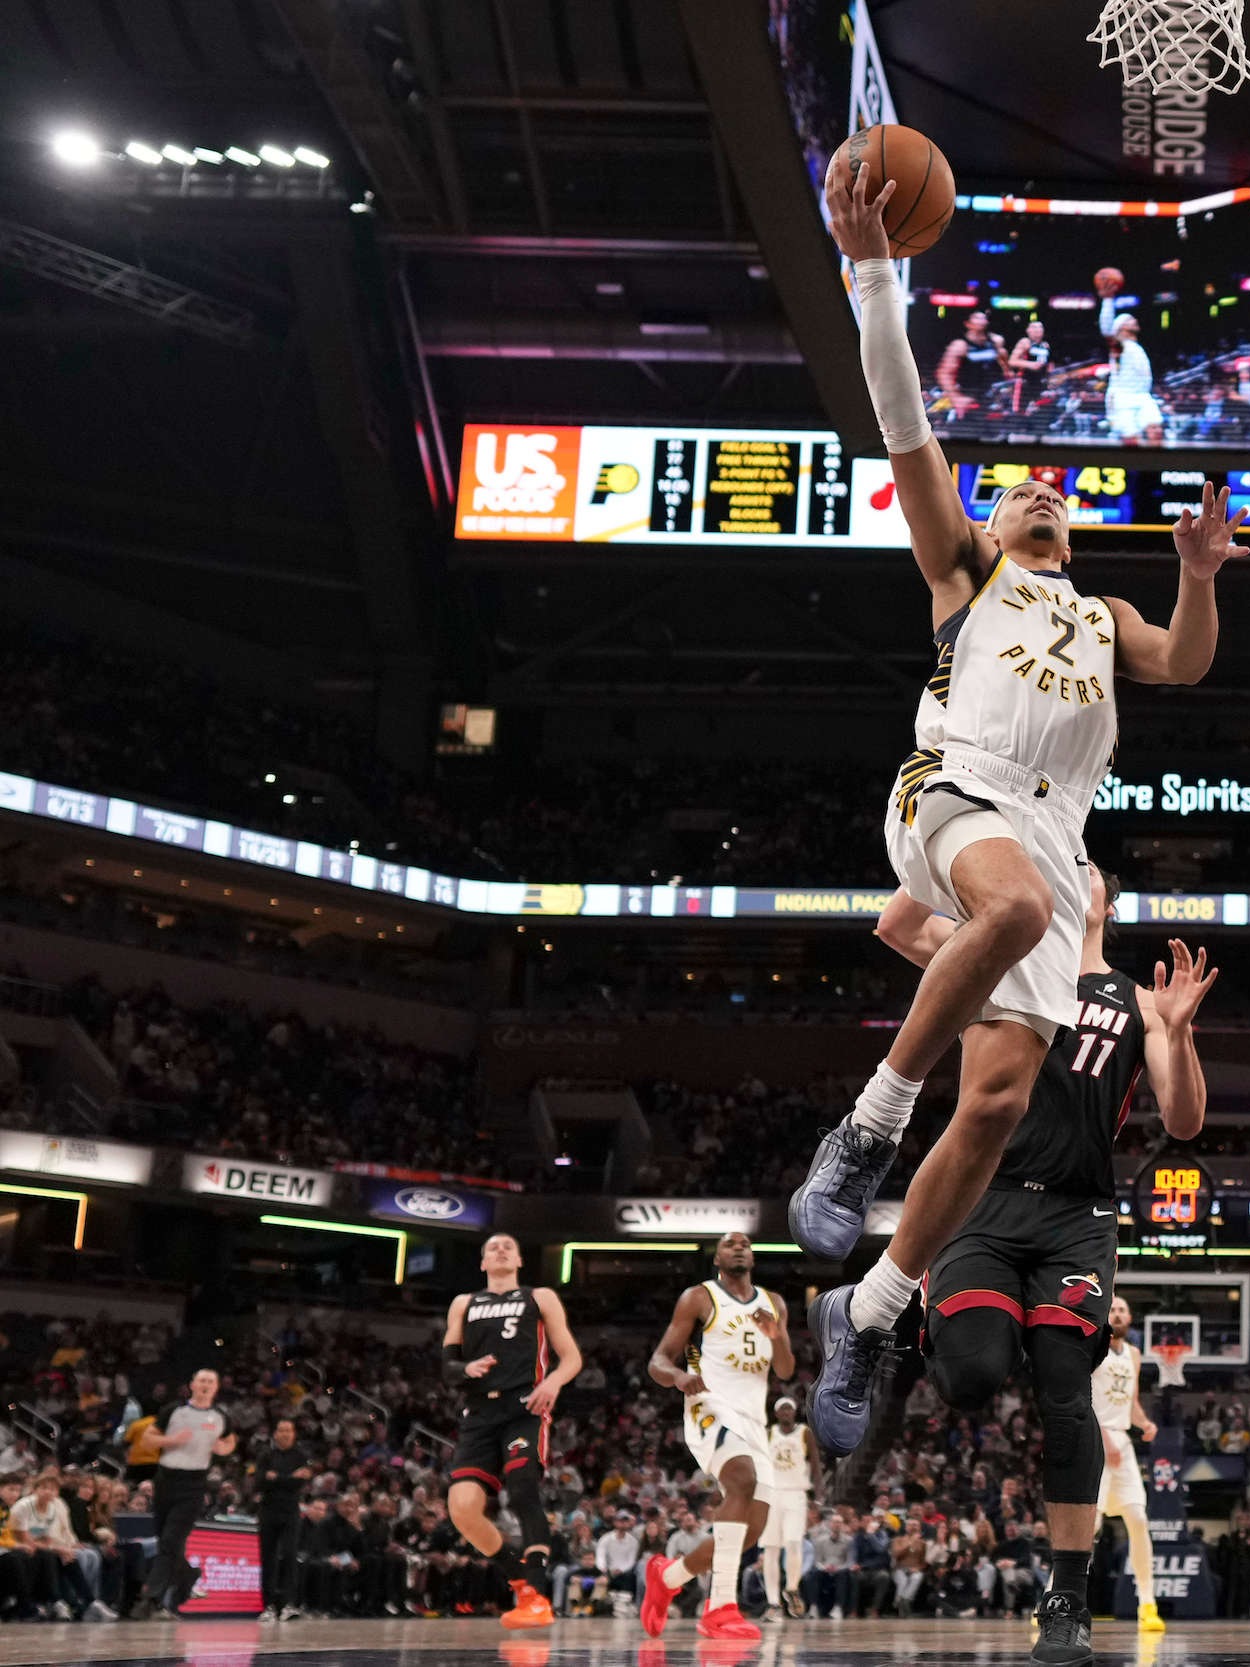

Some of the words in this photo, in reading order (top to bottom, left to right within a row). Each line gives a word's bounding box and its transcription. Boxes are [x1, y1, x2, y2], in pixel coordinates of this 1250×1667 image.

[1154, 0, 1209, 175] AINBRIDGE
[1075, 466, 1126, 496] 43
[1001, 585, 1112, 645] INDIANA
[1048, 610, 1077, 668] 2
[998, 644, 1105, 705] PACERS
[1094, 772, 1153, 811] Sire
[153, 821, 188, 844] 7/9
[774, 893, 849, 912] INDIANA
[852, 894, 893, 912] PAC
[1149, 897, 1216, 920] 10:08
[1070, 1033, 1117, 1079] 11
[226, 1168, 315, 1200] DEEM
[1154, 1169, 1200, 1190] 10:08
[407, 1190, 451, 1215] Ford
[1158, 1235, 1206, 1247] TISSOT
[467, 1301, 526, 1323] MIAMI
[501, 1317, 519, 1339] 5
[743, 1331, 756, 1356] 5
[725, 1352, 770, 1374] PACERS
